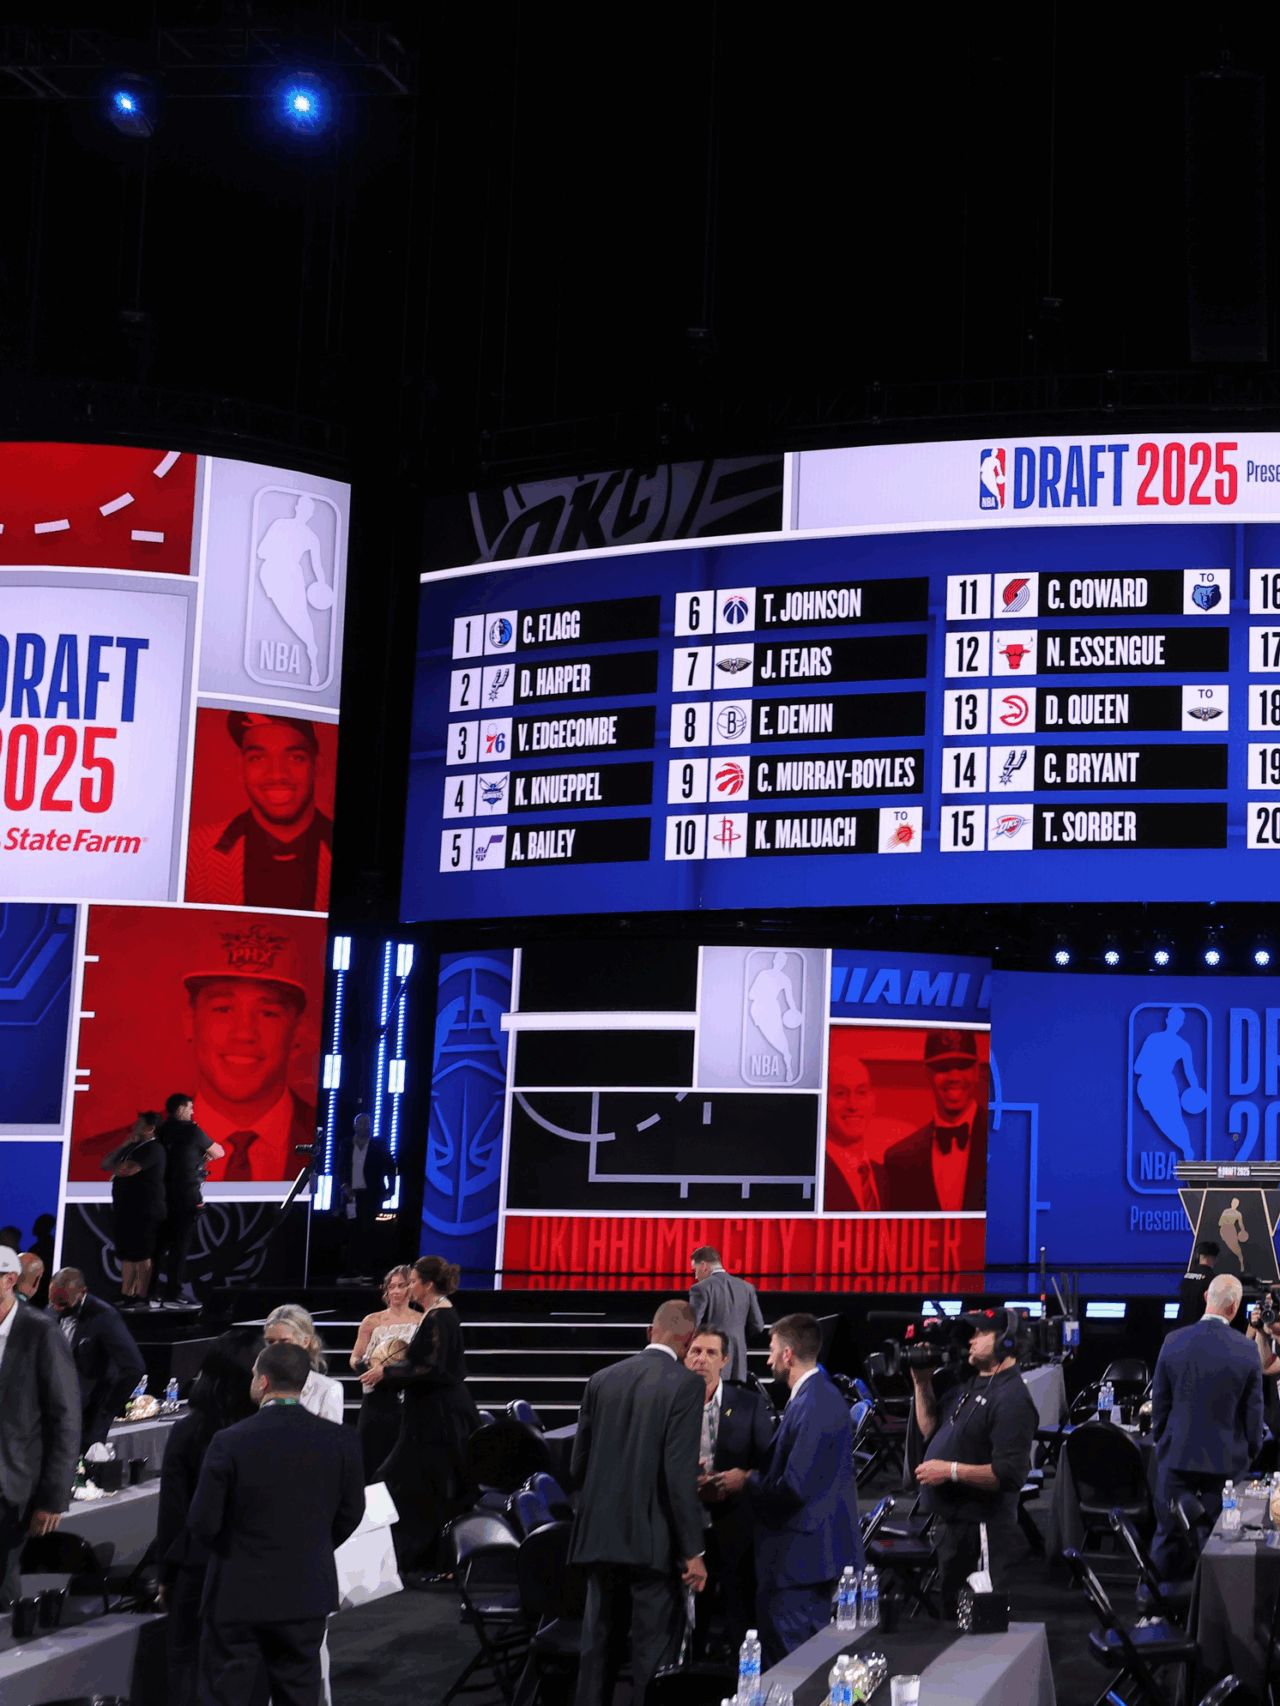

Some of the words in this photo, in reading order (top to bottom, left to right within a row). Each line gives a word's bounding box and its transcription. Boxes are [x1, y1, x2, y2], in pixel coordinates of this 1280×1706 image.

[1013, 444, 1129, 509] DRAFT
[1137, 442, 1238, 506] 2025
[689, 597, 699, 630] 6
[764, 594, 776, 622] T.
[780, 589, 861, 621] JOHNSON
[960, 580, 977, 614] 11
[1048, 580, 1064, 609] C.
[1070, 578, 1147, 608] COWARD
[1200, 574, 1214, 582] TO
[466, 622, 470, 652] 1
[523, 616, 535, 643] C.
[538, 611, 580, 641] FLAGG
[259, 640, 301, 674] NBA
[688, 652, 698, 685] 7
[761, 650, 775, 678] J.
[781, 647, 832, 677] FEARS
[957, 637, 978, 671] 12
[1047, 637, 1064, 666] N.
[1070, 636, 1165, 666] ESSENGUE
[461, 674, 470, 706] 2
[520, 670, 533, 697] D.
[536, 664, 590, 695] HARPER
[685, 708, 695, 742] 8
[760, 707, 773, 735] E.
[778, 703, 833, 734] DEMIN
[955, 694, 977, 729] 13
[1046, 695, 1063, 724] D.
[1068, 694, 1128, 724] QUEEN
[1199, 689, 1212, 698] TO
[458, 727, 467, 761] 3
[519, 724, 529, 751] V.
[532, 716, 617, 750] EDGECOMBE
[486, 734, 505, 754] 76
[0, 724, 117, 813] 025
[683, 764, 693, 798] 9
[758, 763, 772, 792] C.
[776, 757, 915, 791] MURRAY-BOYLES
[954, 753, 975, 787] 14
[1044, 753, 1061, 783] C.
[1066, 753, 1139, 782] BRYANT
[455, 781, 463, 812] 4
[515, 778, 527, 805] K.
[531, 773, 602, 804] KNUEPPEL
[452, 834, 461, 866] 5
[512, 833, 524, 860] A.
[528, 829, 575, 859] BAILEY
[676, 820, 695, 855] 10
[755, 820, 770, 849] K.
[775, 817, 856, 848] MALUACH
[952, 811, 974, 846] 15
[1043, 812, 1057, 841] T.
[1062, 811, 1136, 842] SORBER
[751, 1054, 779, 1076] NBA
[1141, 1152, 1177, 1181] NBA
[1130, 1205, 1192, 1232] Present
[722, 1219, 796, 1273] CITY
[815, 1219, 961, 1273] THUNDER
